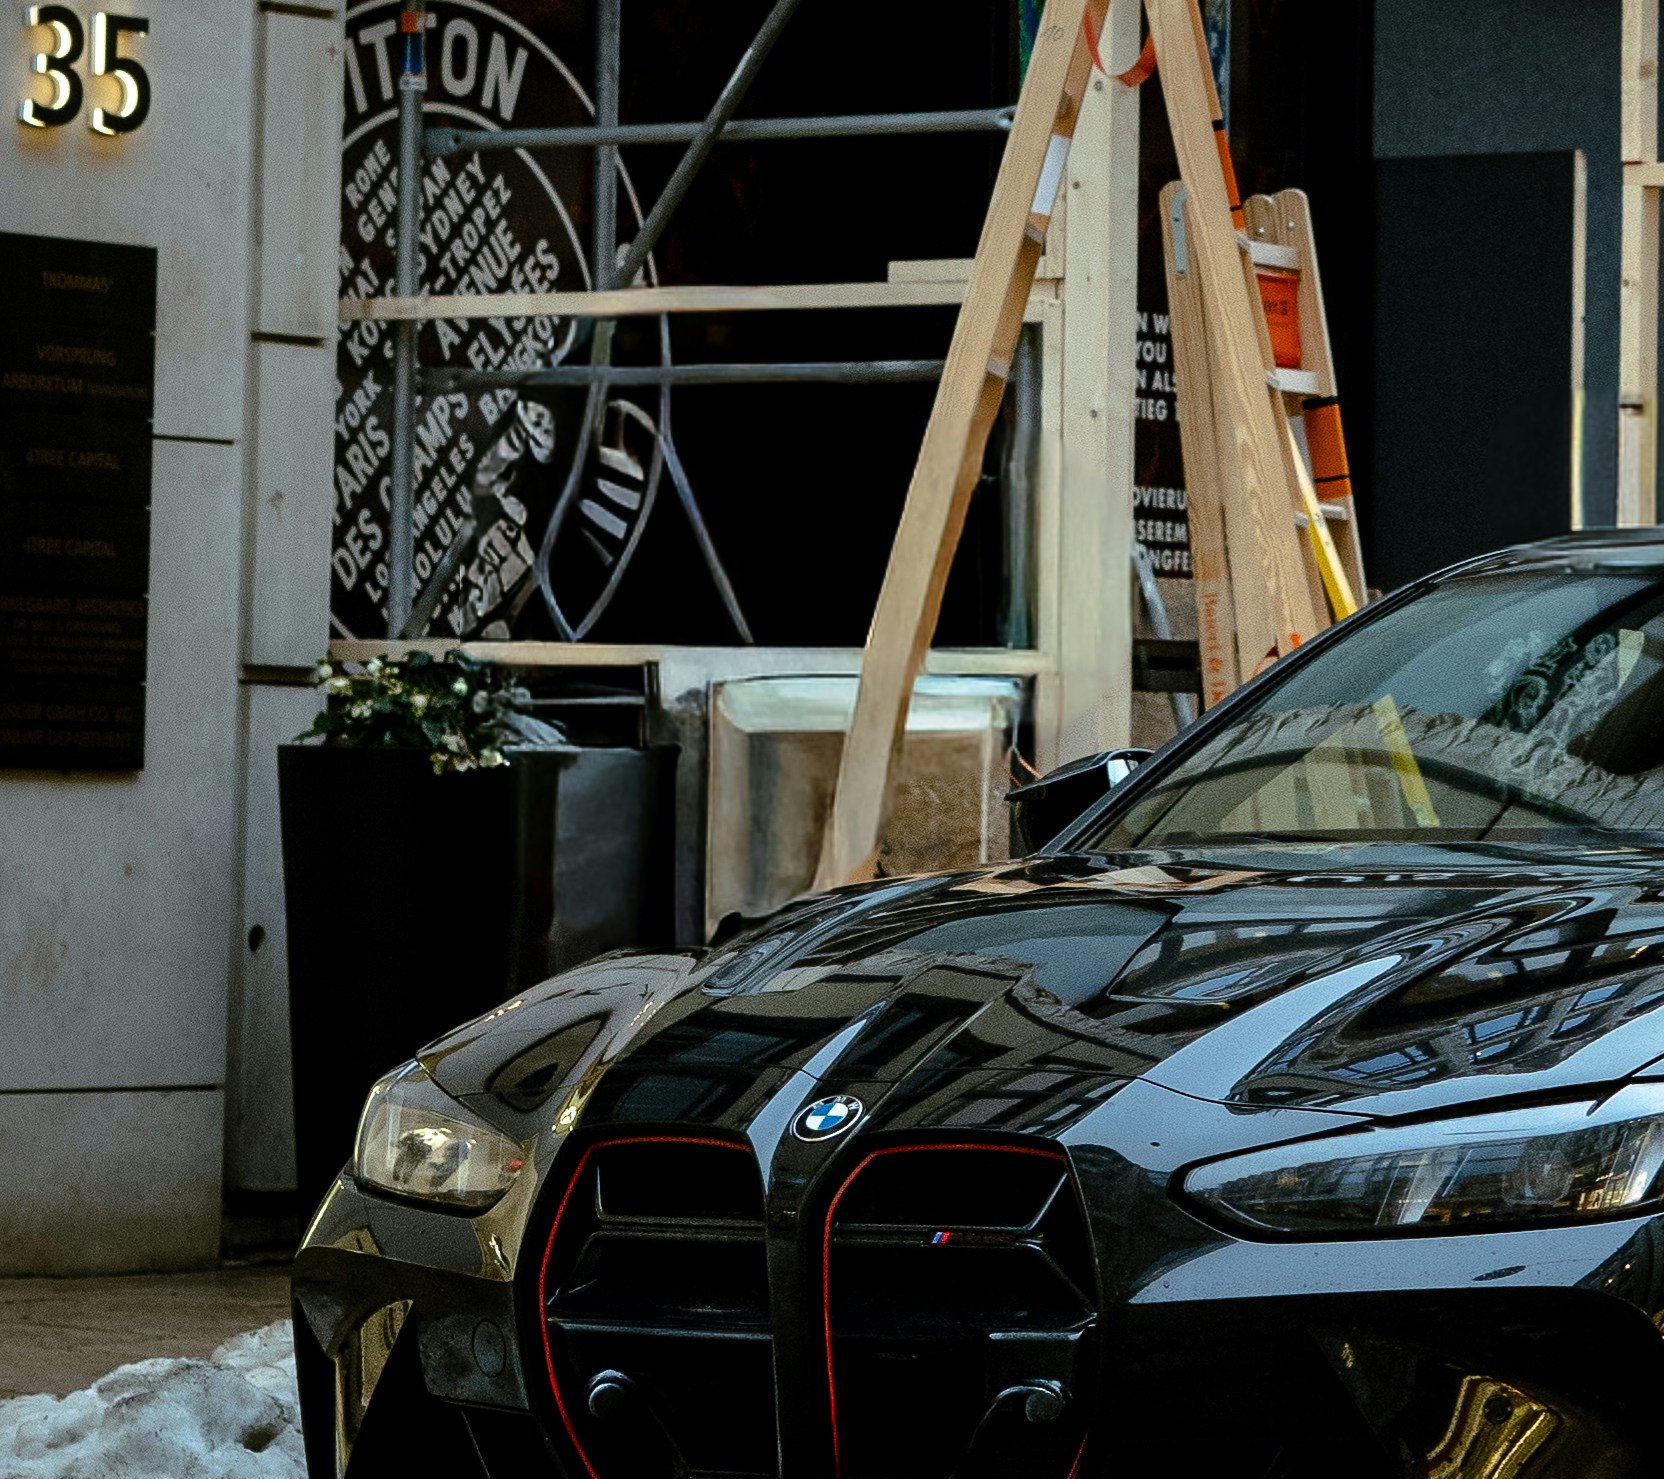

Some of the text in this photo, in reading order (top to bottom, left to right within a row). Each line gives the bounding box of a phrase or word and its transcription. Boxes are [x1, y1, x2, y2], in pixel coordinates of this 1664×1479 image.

[18, 5, 151, 136] 35
[346, 139, 391, 210] ROME
[69, 451, 121, 471] CAPITAL
[379, 391, 469, 512] CAMPS
[332, 507, 383, 591] DES
